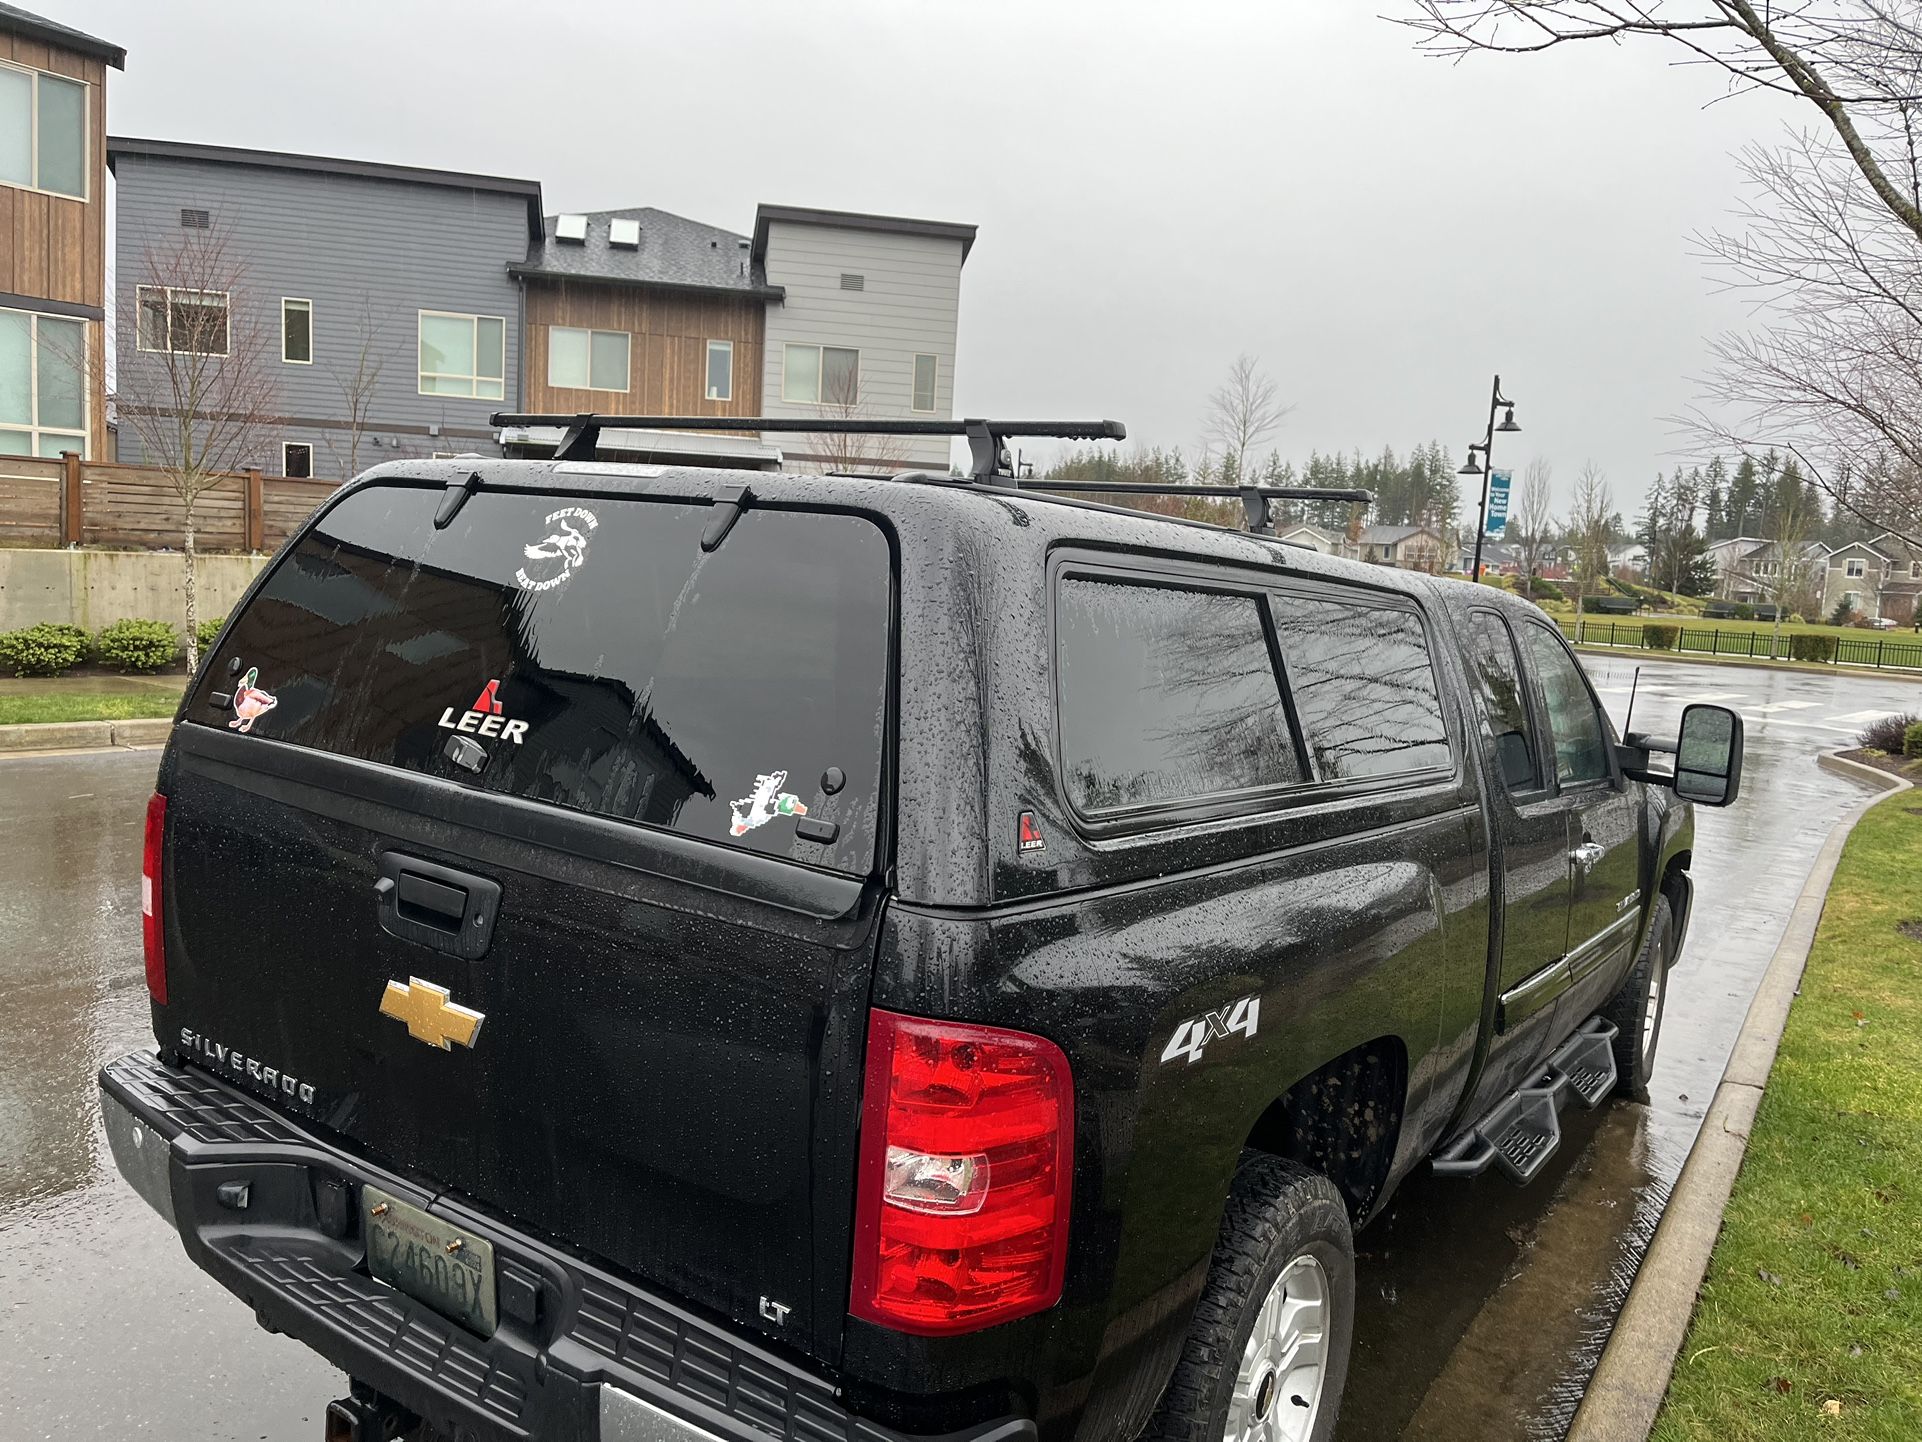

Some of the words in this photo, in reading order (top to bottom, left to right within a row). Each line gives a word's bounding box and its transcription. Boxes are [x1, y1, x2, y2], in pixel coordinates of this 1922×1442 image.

[545, 507, 575, 525] FEET
[573, 507, 599, 530] DOWN
[515, 567, 536, 591] BEAT
[534, 568, 571, 591] DOWN
[438, 706, 530, 745] LEER
[1020, 840, 1043, 849] LEER
[180, 1027, 317, 1105] SILVERADO
[759, 1295, 792, 1326] LT
